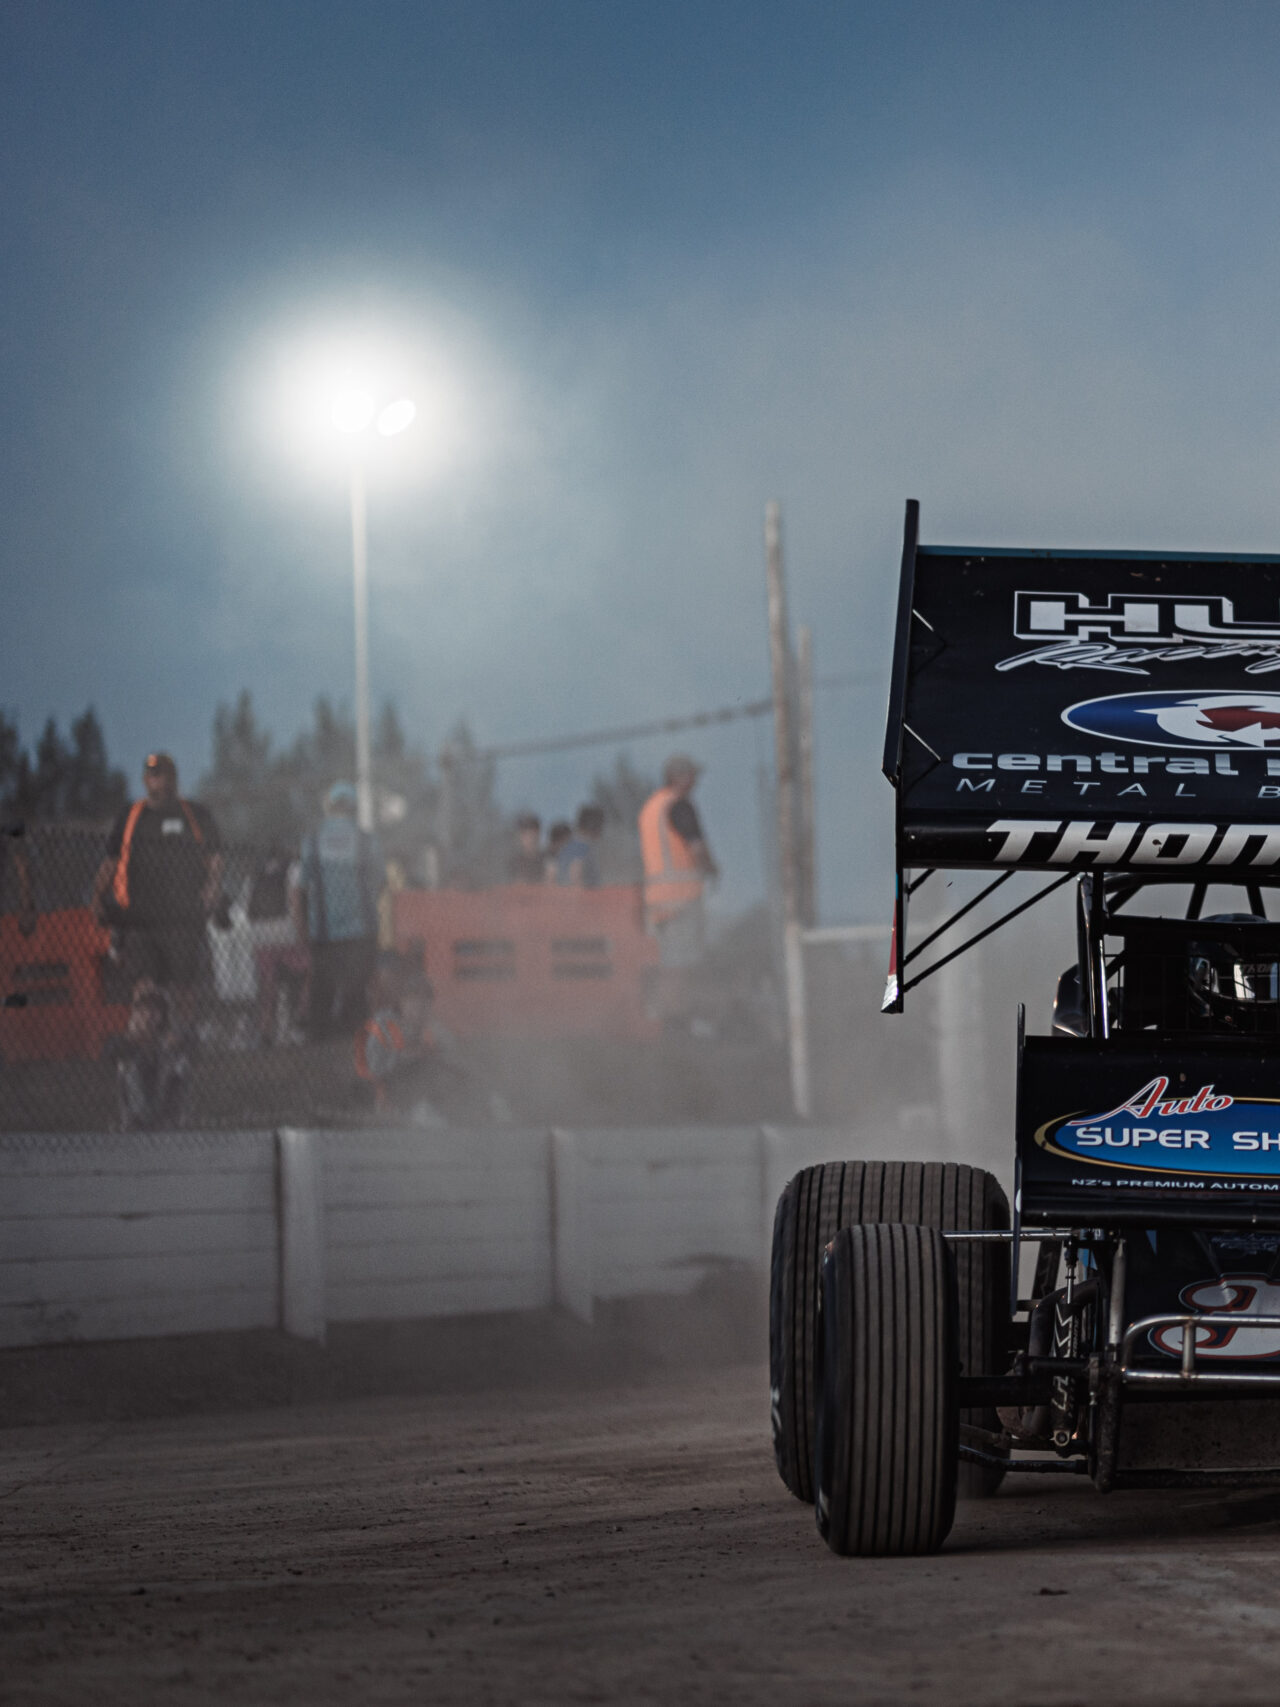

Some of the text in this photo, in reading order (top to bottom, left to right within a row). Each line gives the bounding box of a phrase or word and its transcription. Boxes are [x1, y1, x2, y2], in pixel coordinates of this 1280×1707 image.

[952, 752, 1239, 775] central
[955, 778, 1196, 797] METAL
[1065, 1076, 1234, 1127] Auto
[1075, 1127, 1211, 1150] SUPER
[1071, 1178, 1112, 1187] NZ's
[1116, 1180, 1205, 1190] PREMIUM
